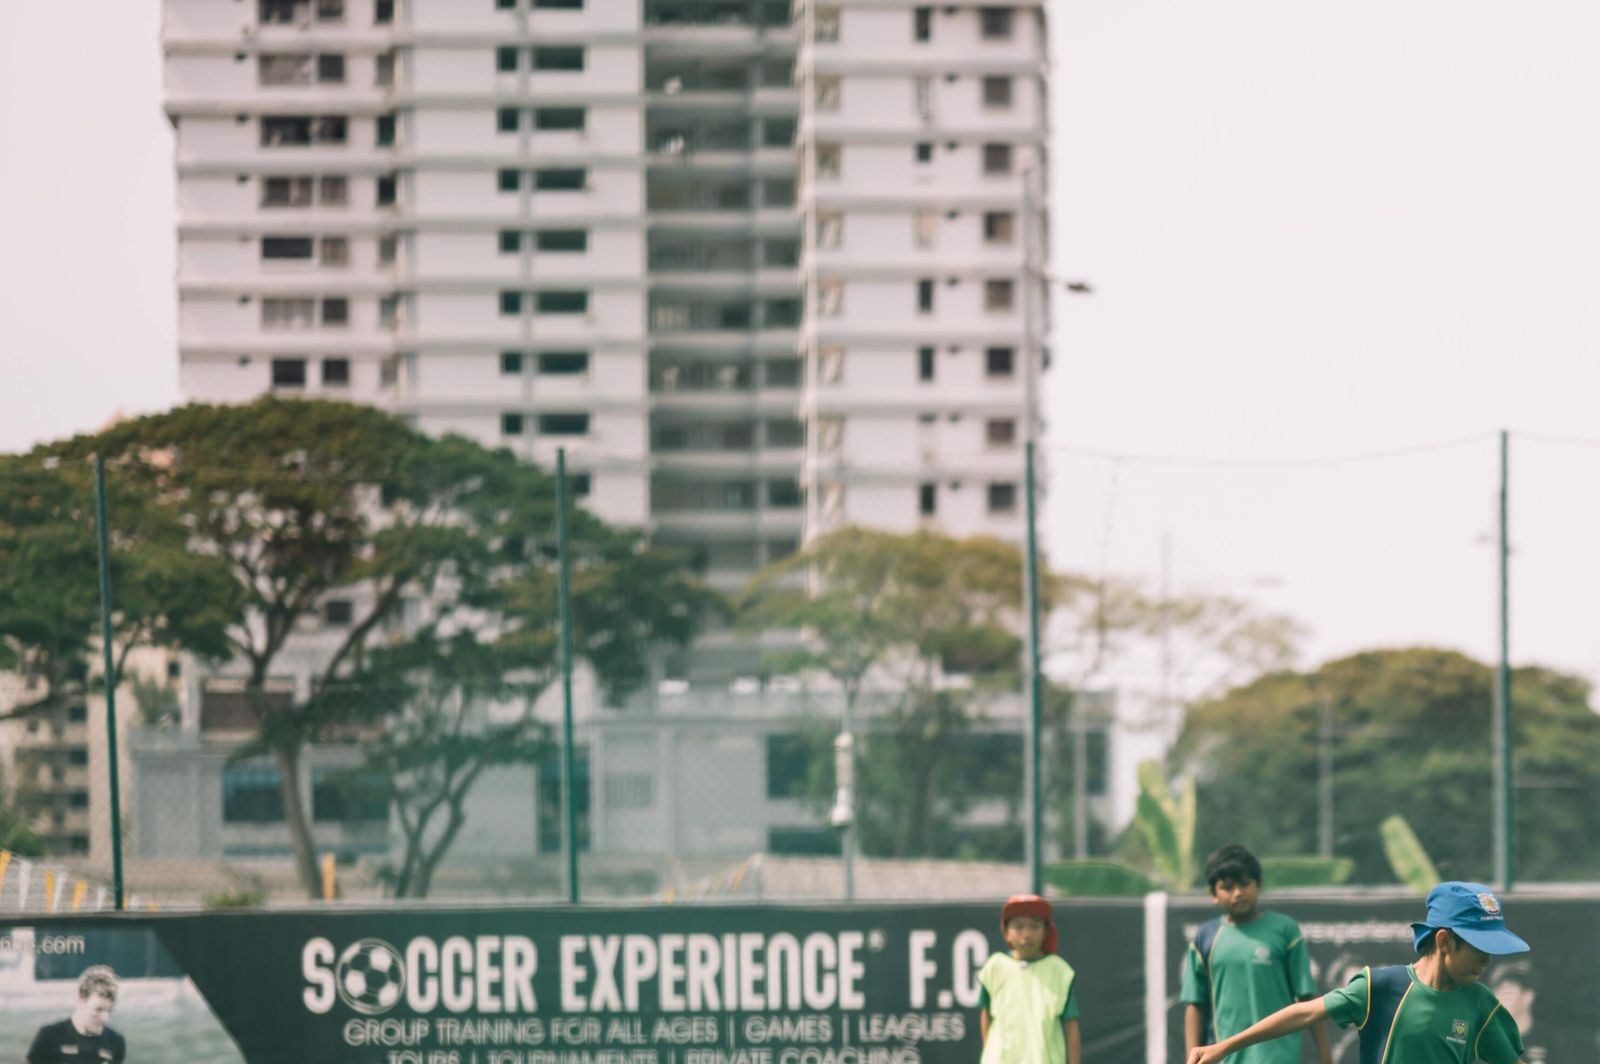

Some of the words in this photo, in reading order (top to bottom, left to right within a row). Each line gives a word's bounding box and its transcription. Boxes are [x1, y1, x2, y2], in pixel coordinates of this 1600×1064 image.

[344, 1017, 430, 1046] GROUP
[436, 1017, 545, 1045] TRAINING
[552, 1016, 601, 1044] FOR
[607, 1016, 648, 1044] ALL
[653, 1015, 719, 1044] AGES
[745, 1014, 833, 1044] GAMES
[858, 1012, 966, 1043] LEAGUES
